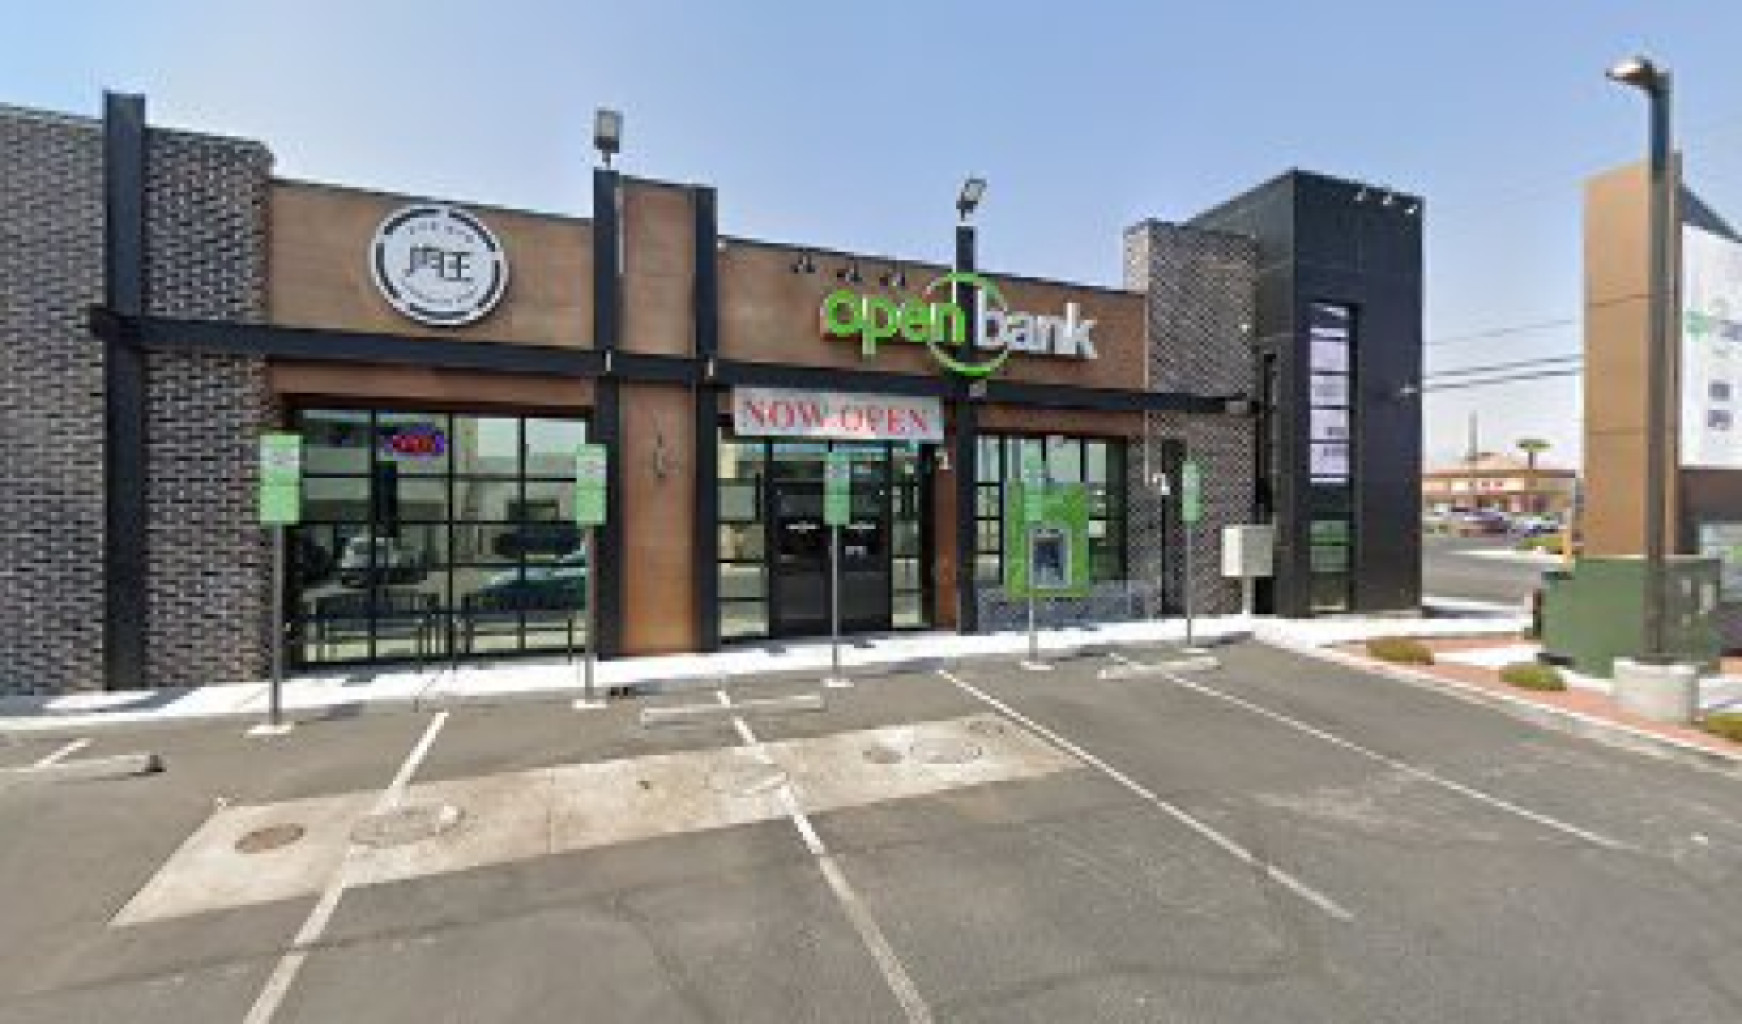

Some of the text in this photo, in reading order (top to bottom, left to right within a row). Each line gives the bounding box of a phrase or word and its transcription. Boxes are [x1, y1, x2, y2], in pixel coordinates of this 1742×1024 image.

[824, 288, 1099, 359] open bank
[742, 400, 931, 435] NOW OPEN
